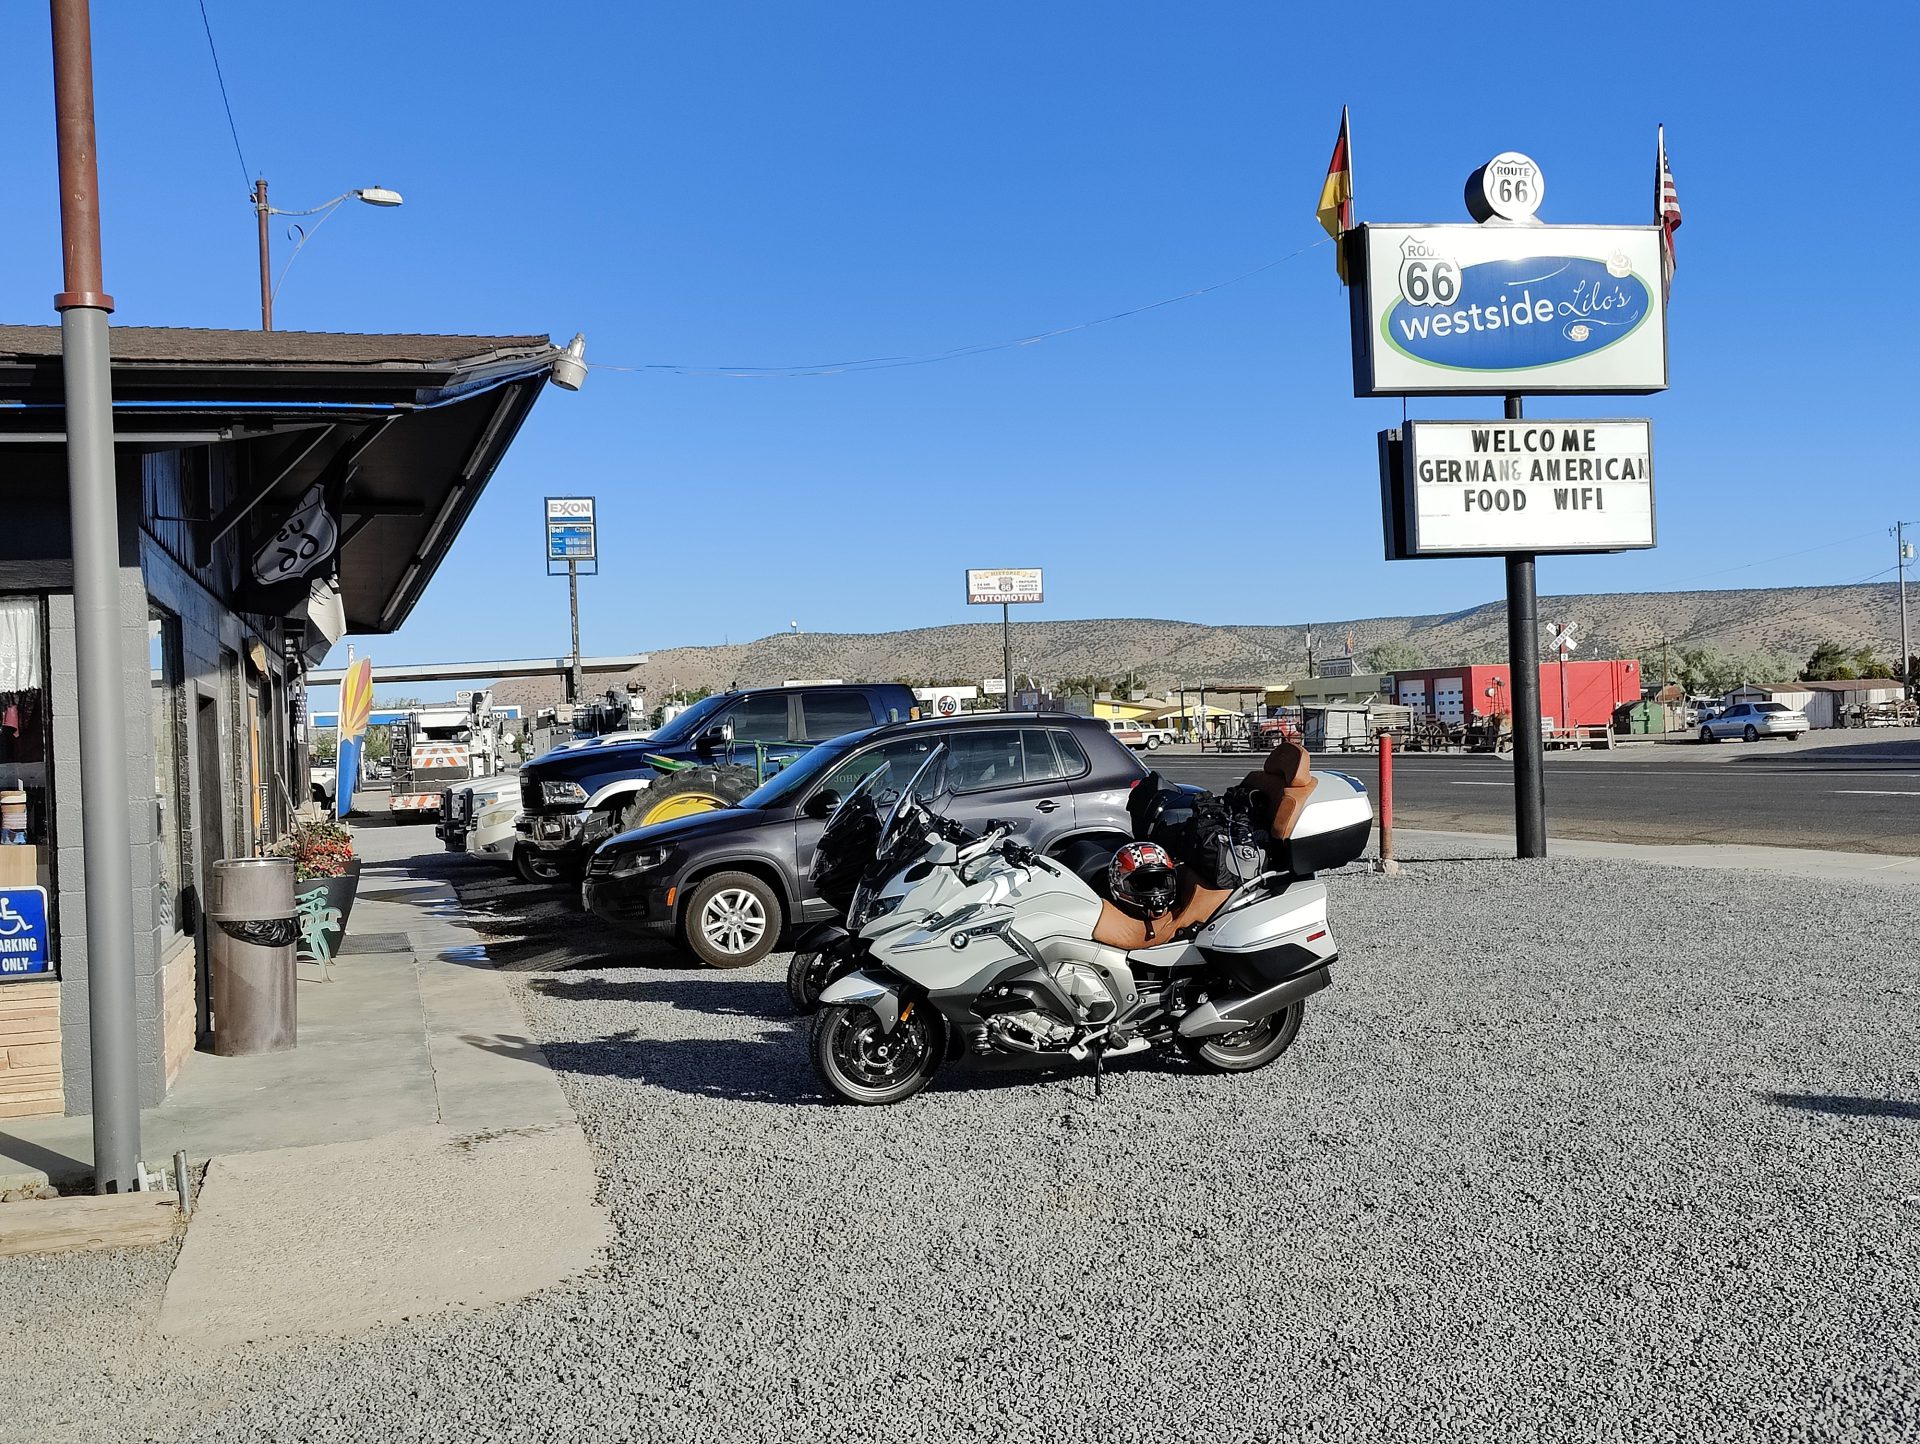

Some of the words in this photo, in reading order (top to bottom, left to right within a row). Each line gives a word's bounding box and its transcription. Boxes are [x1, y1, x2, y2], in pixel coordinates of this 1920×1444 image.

[1496, 166, 1530, 177] ROUTE
[1499, 178, 1528, 203] 66
[1406, 261, 1454, 301] 66
[1399, 289, 1555, 342] westside
[1557, 279, 1633, 318] Lilo's
[1471, 429, 1596, 453] WELCOME
[1529, 457, 1649, 482] AMERICAN
[550, 502, 590, 516] EXXON
[1464, 488, 1527, 512] FOOD
[1553, 487, 1604, 511] WIFI
[974, 594, 1040, 603] AUTOMOTIVE
[1550, 622, 1578, 650] CROSSING
[940, 701, 955, 713] 76
[0, 937, 37, 953] ARKING
[2, 957, 29, 972] ONLY
